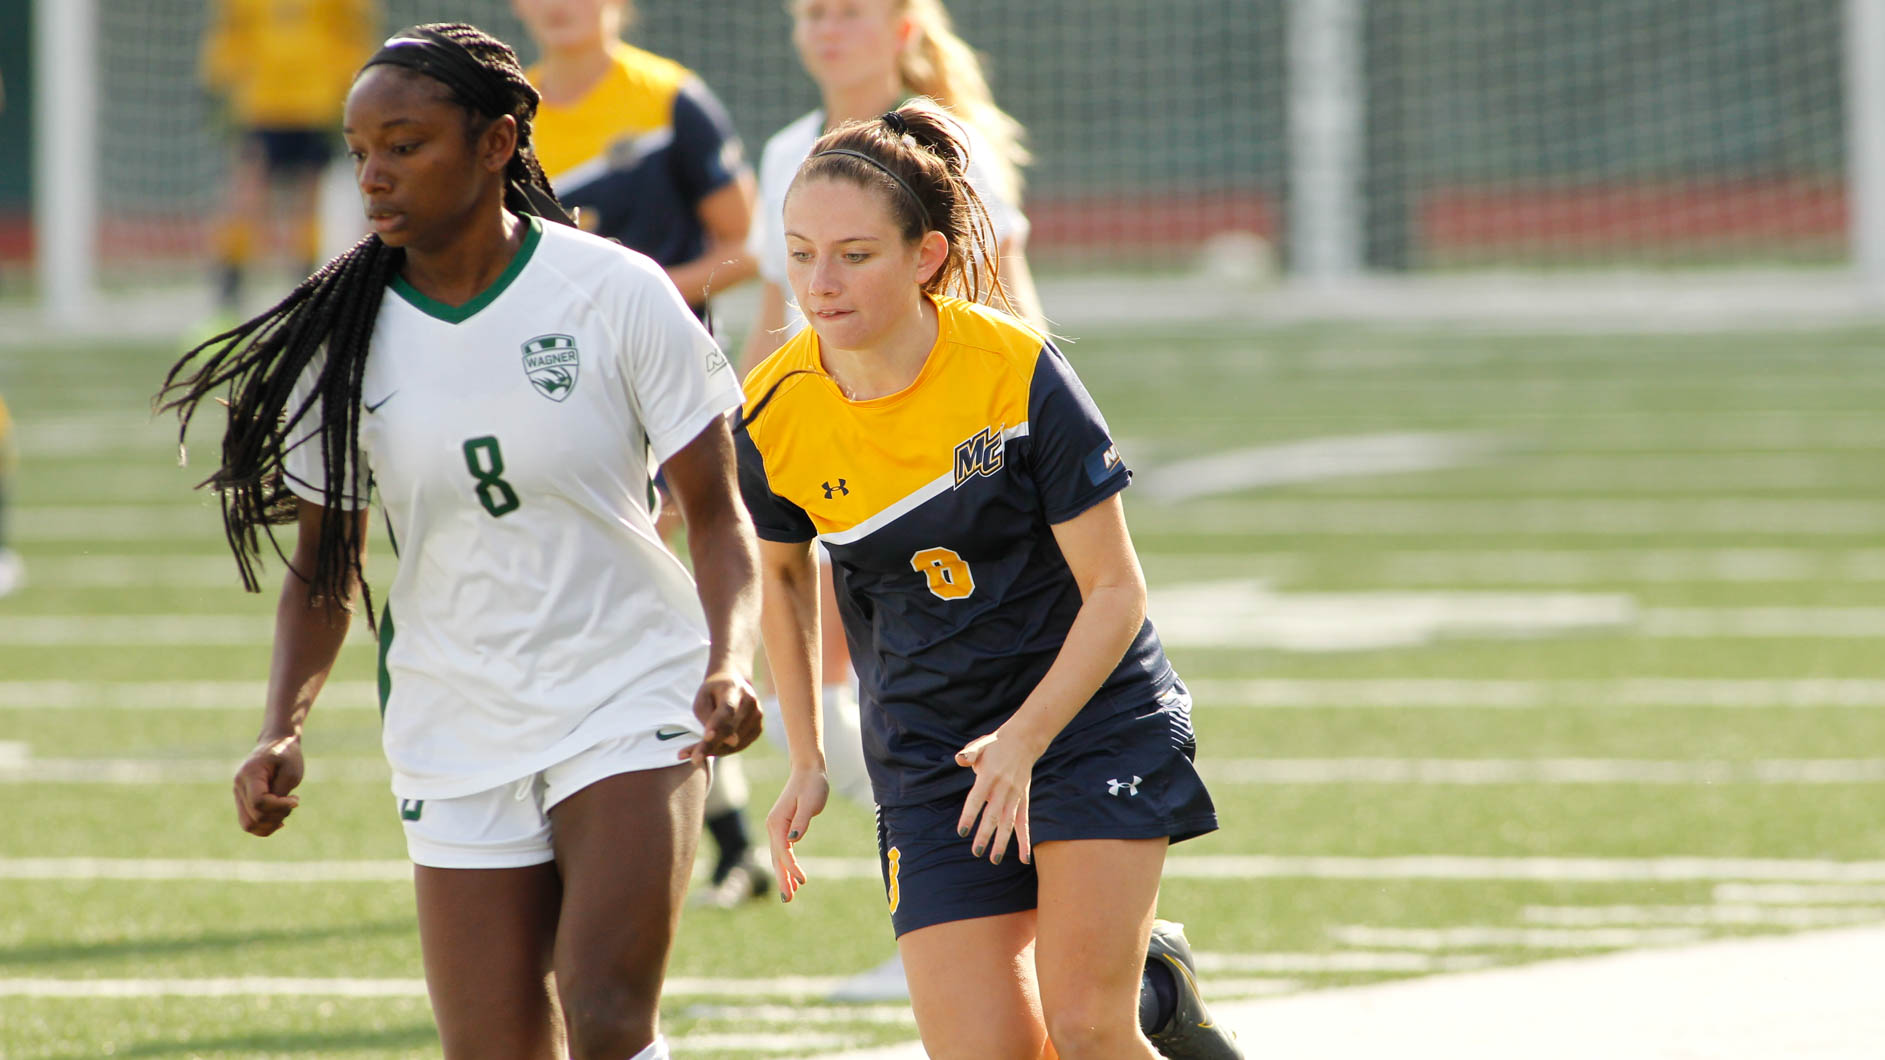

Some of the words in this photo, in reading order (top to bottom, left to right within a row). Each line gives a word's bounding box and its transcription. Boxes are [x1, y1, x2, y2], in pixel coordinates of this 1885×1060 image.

[527, 350, 576, 368] WAGNER
[463, 436, 521, 518] 8
[953, 424, 1004, 491] MC
